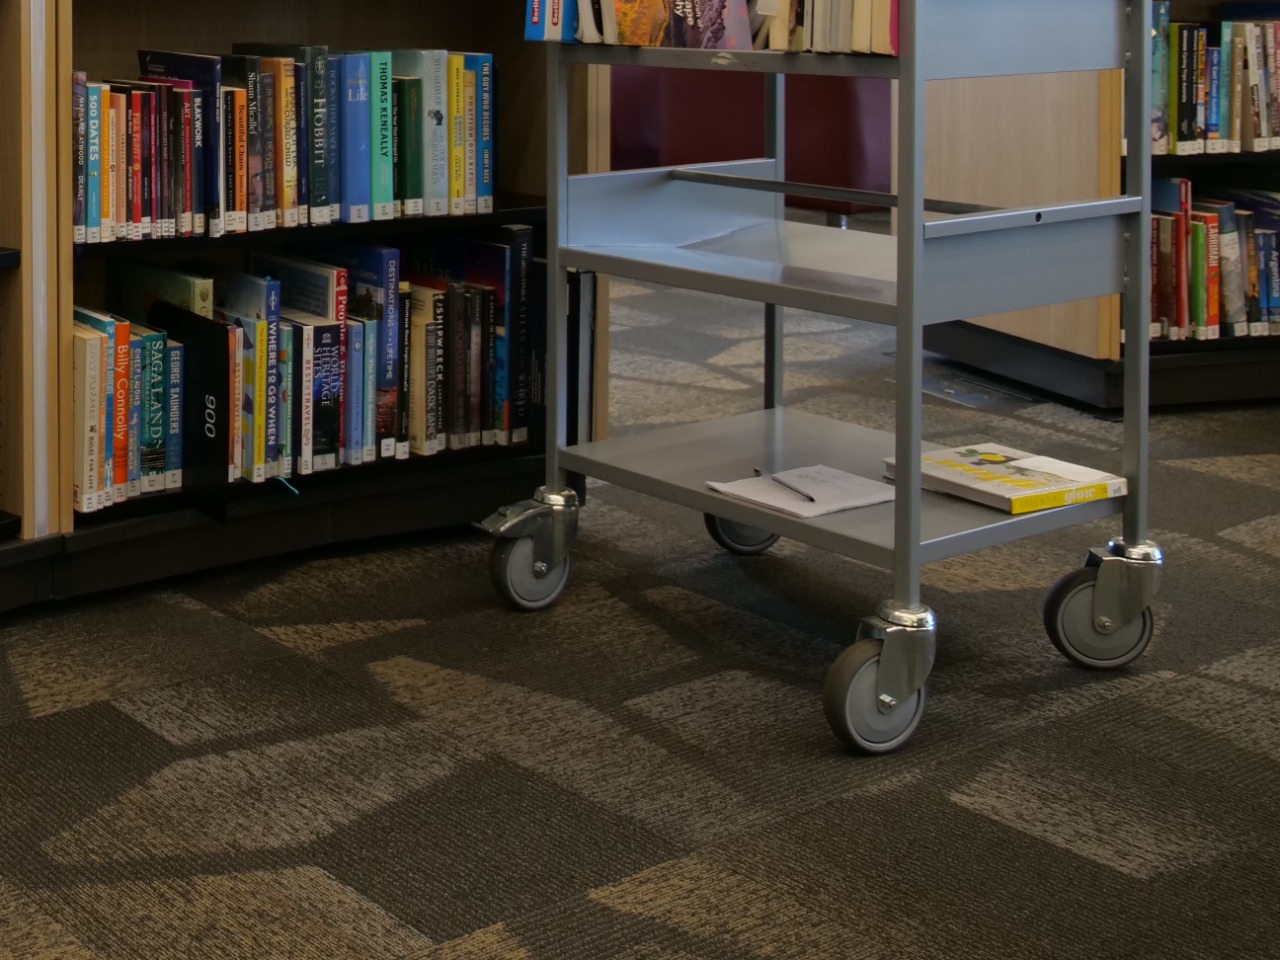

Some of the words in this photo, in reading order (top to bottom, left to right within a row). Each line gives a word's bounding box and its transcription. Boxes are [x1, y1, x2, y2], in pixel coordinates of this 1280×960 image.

[348, 91, 368, 102] Life
[379, 61, 388, 103] THOMAS
[194, 97, 202, 148] BLAKWORK
[314, 97, 326, 167] HOBBIT
[379, 106, 388, 157] KENEALLY
[115, 344, 129, 373] Billy
[314, 347, 322, 378] SITES
[321, 346, 330, 406] HERITAGE
[330, 345, 338, 390] WORLD
[114, 378, 128, 439] Connolly
[205, 394, 216, 438] 900
